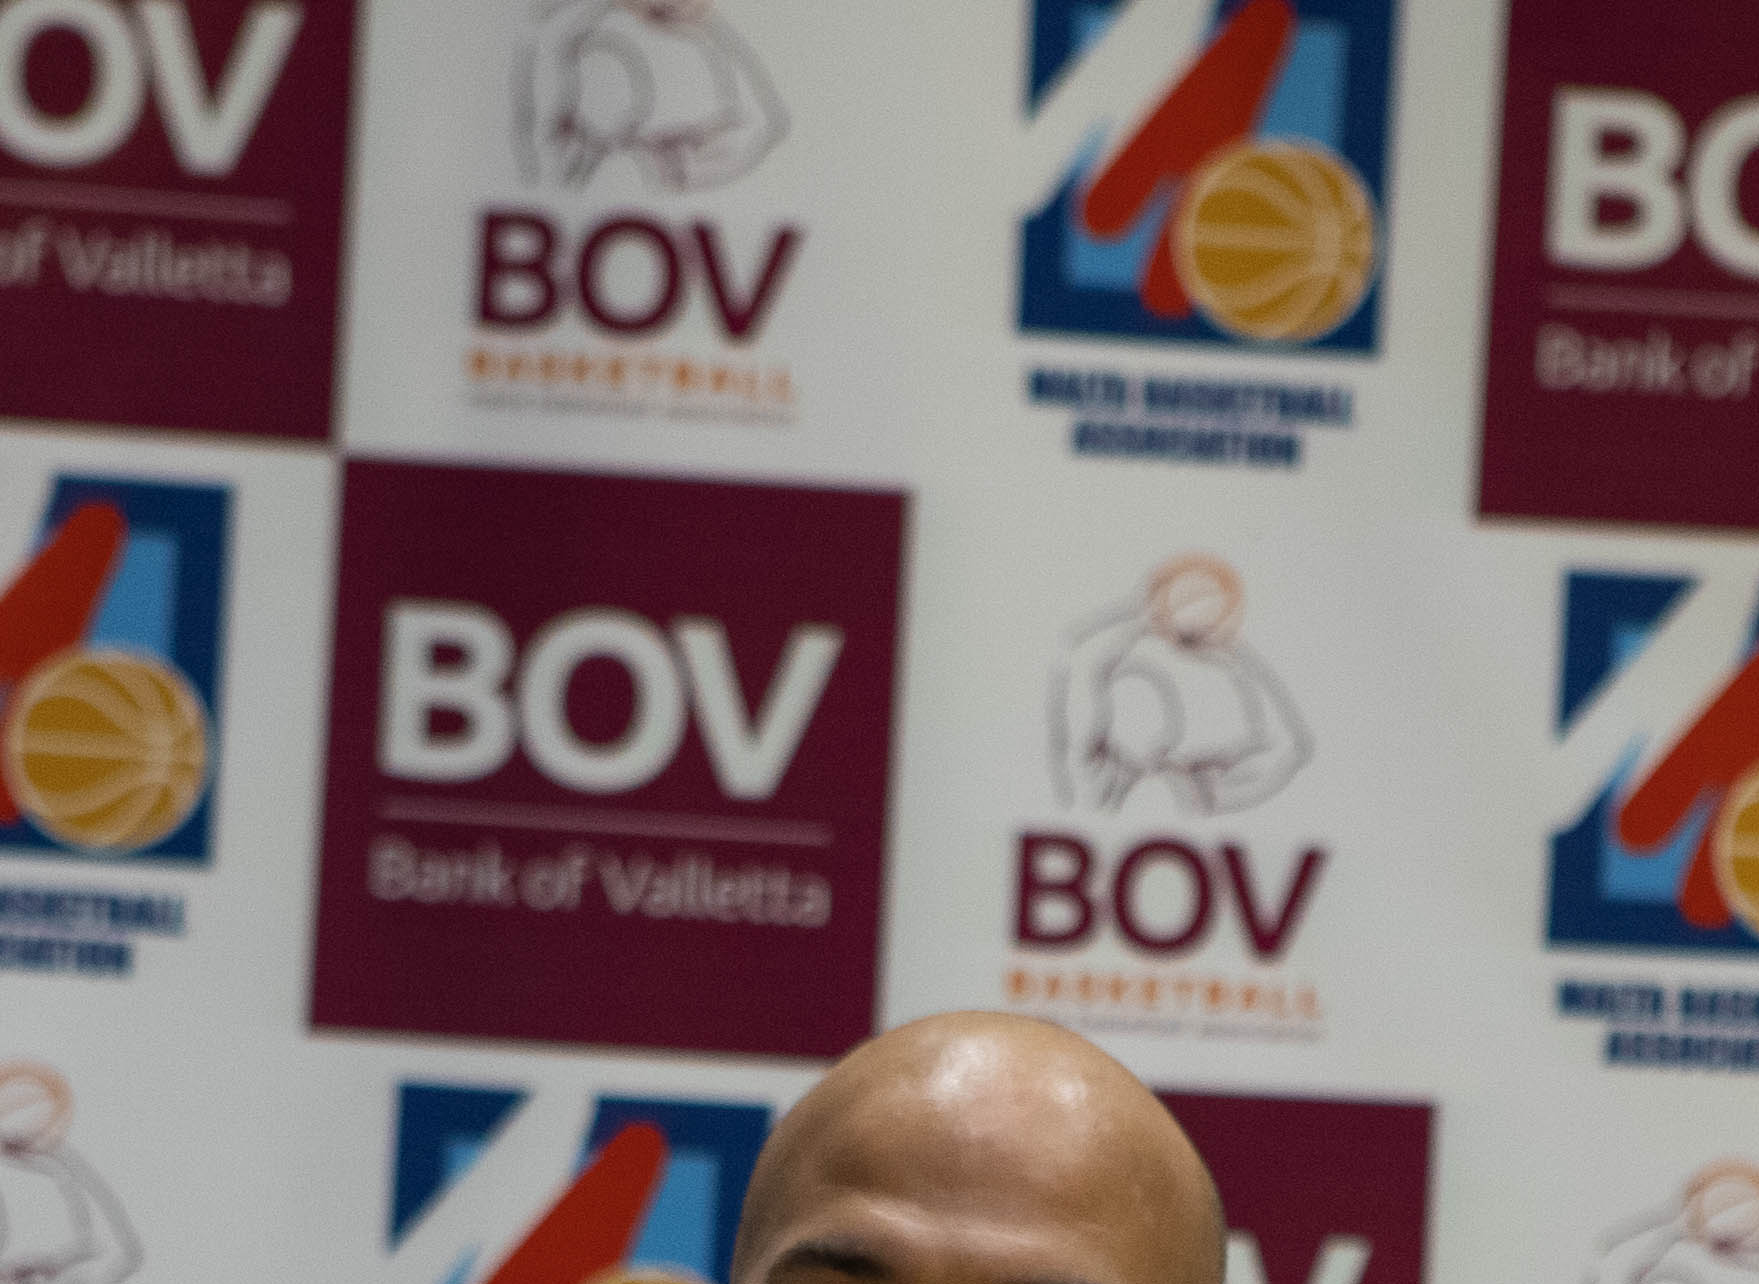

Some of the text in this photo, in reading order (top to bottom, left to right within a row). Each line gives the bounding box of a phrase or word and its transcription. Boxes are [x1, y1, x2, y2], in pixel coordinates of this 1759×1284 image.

[50, 233, 293, 310] Valletta
[473, 208, 804, 343] BOV
[1534, 323, 1681, 394] Bank
[1688, 330, 1759, 401] of
[377, 598, 845, 802] BOV
[366, 834, 832, 928] Bank of Valletta
[1013, 832, 1328, 964] BOV
